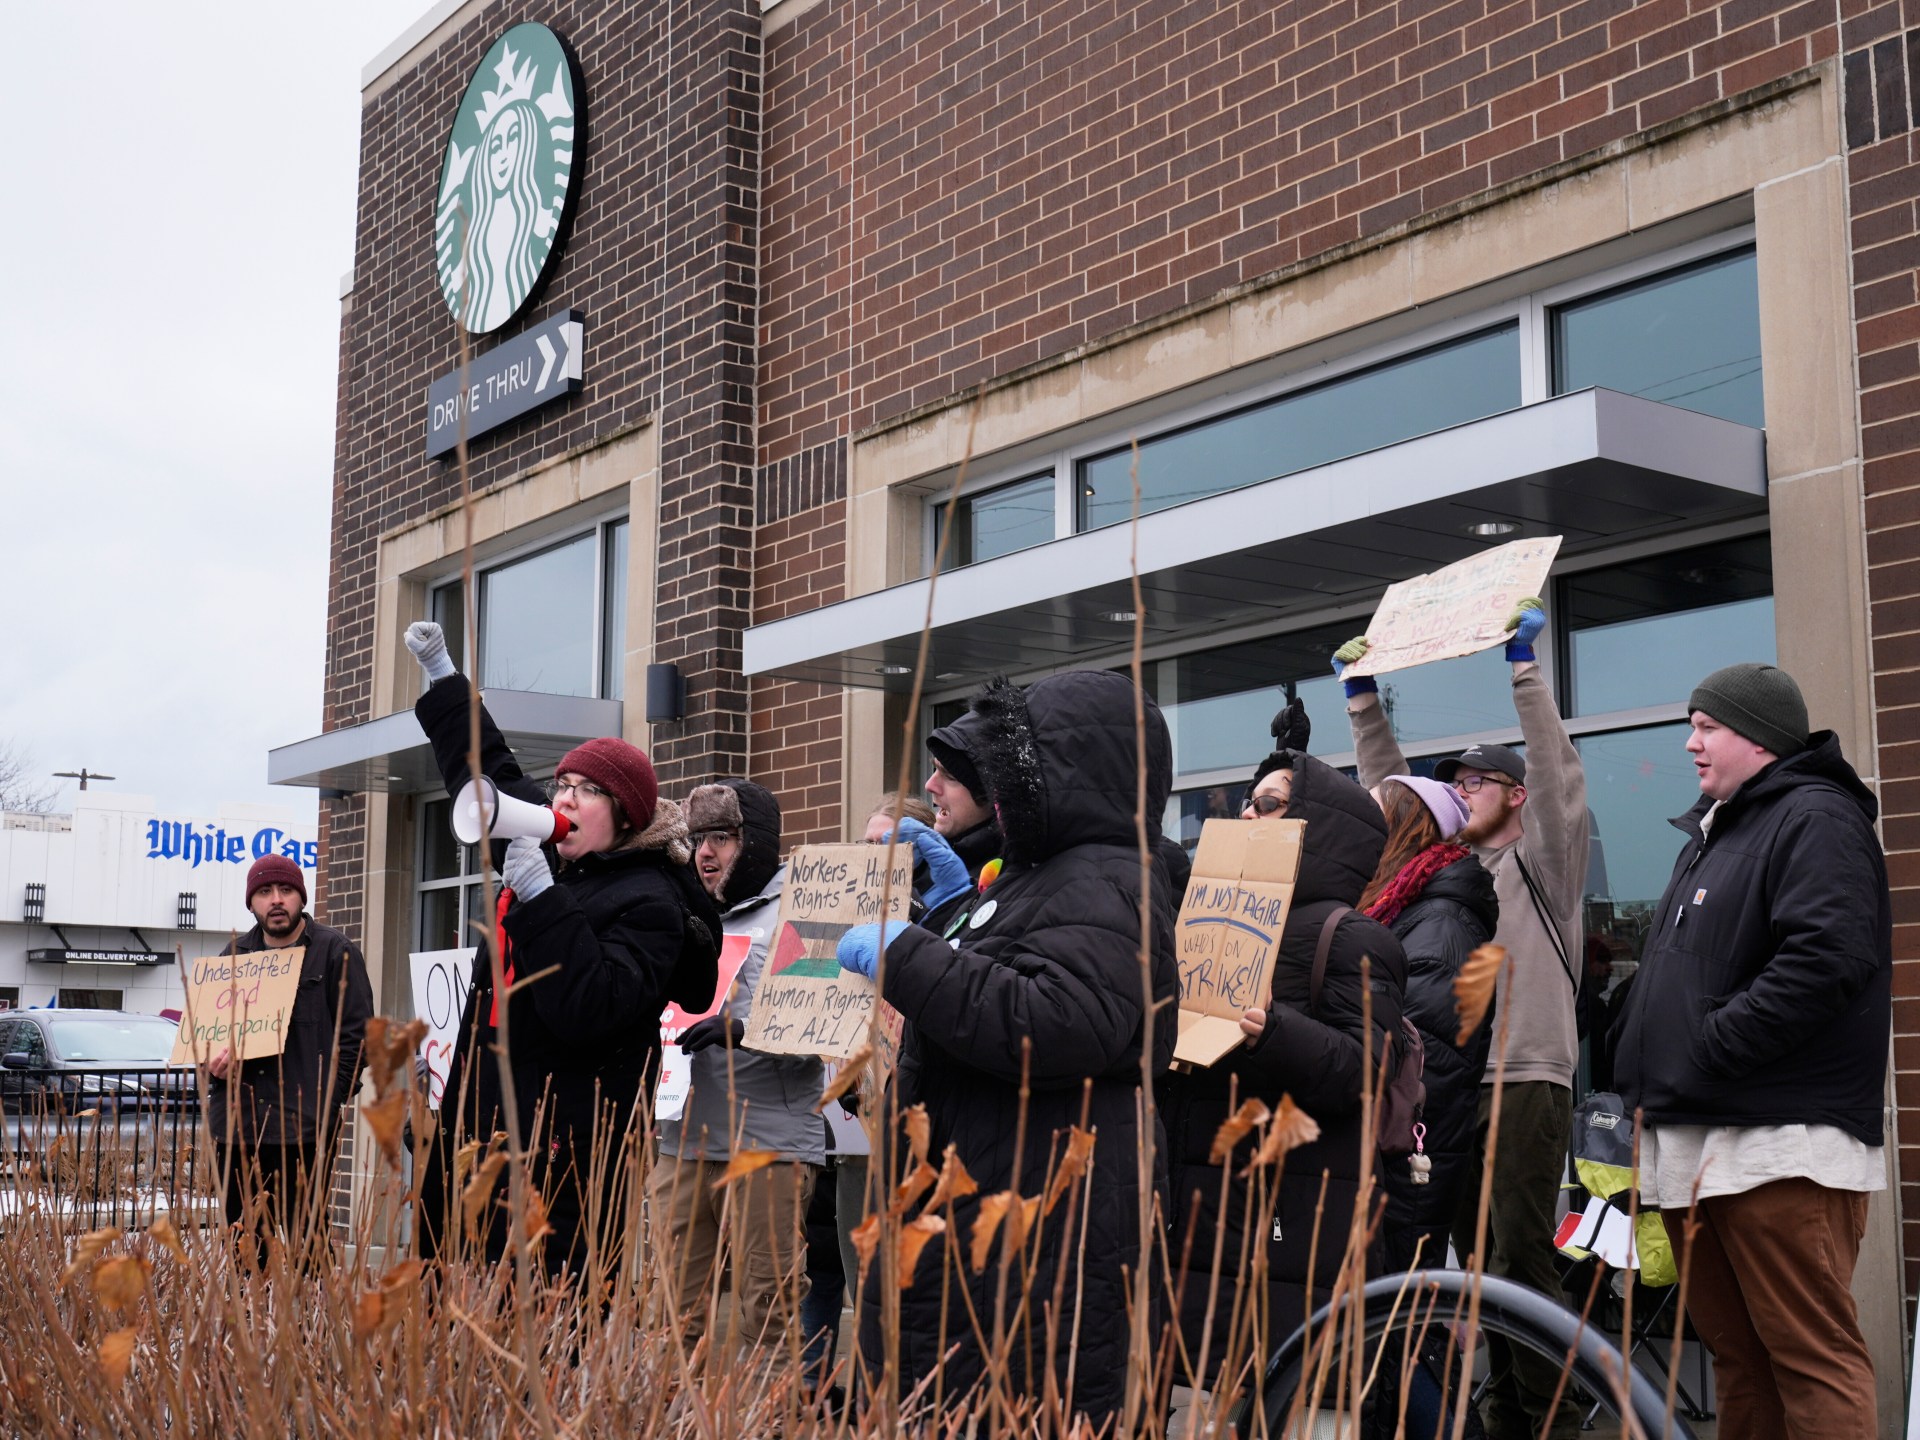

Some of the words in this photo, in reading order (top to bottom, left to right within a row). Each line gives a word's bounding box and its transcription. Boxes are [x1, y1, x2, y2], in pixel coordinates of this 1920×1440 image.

[433, 384, 481, 432] DRIVE
[486, 356, 532, 404] THRU
[146, 819, 245, 869] White
[790, 854, 848, 884] Workers
[792, 888, 840, 919] Rights
[856, 890, 899, 921] Righs
[1187, 883, 1208, 909] I'M
[1207, 885, 1248, 912] JUST
[65, 951, 92, 960] ONLINE
[93, 952, 128, 961] DELIVERY
[129, 953, 158, 962] PICK-UP
[1184, 928, 1216, 954] WHO'S
[1224, 938, 1248, 959] ON
[216, 980, 260, 1010] and
[760, 983, 816, 1009] Human
[822, 985, 874, 1020] Rights
[763, 1014, 794, 1041] for
[659, 1094, 680, 1102] UNITED
